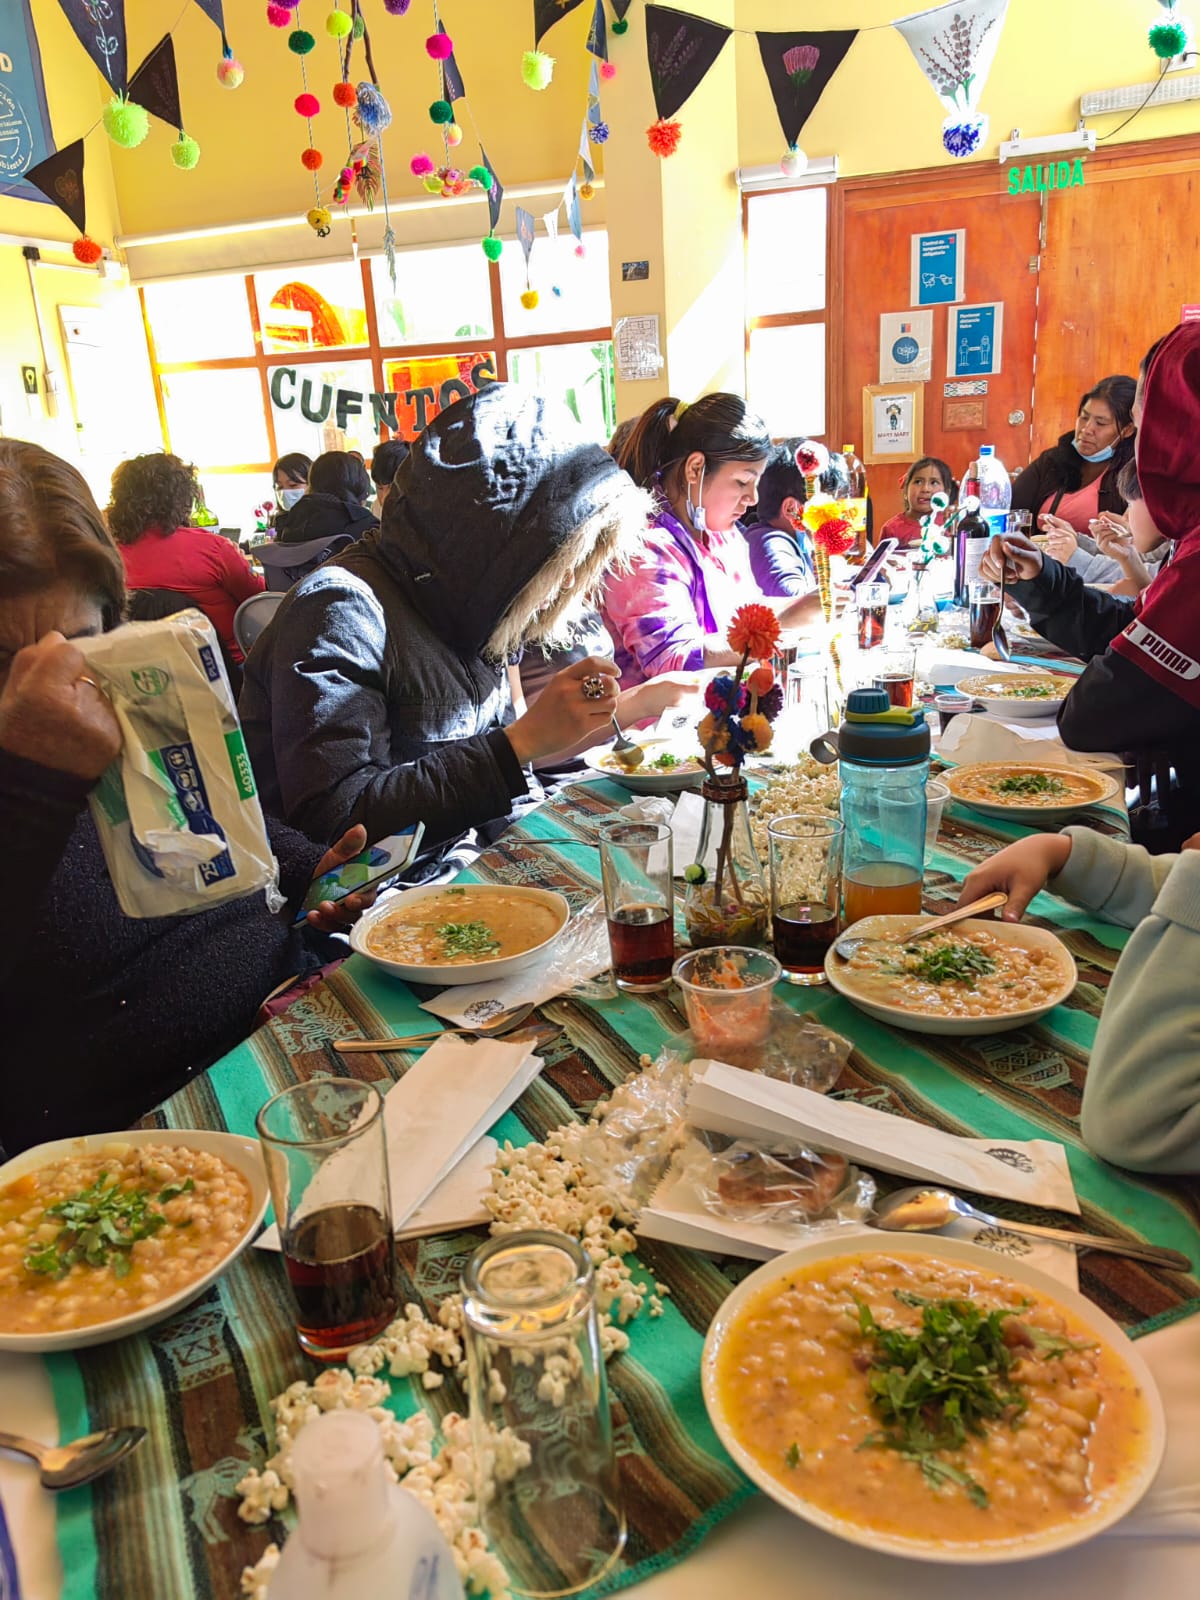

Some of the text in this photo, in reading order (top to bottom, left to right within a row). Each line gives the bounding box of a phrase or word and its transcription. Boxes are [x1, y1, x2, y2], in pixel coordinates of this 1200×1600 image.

[1008, 159, 1085, 195] SALIDA
[1139, 632, 1193, 674] PUMA
[201, 860, 220, 880] 25
